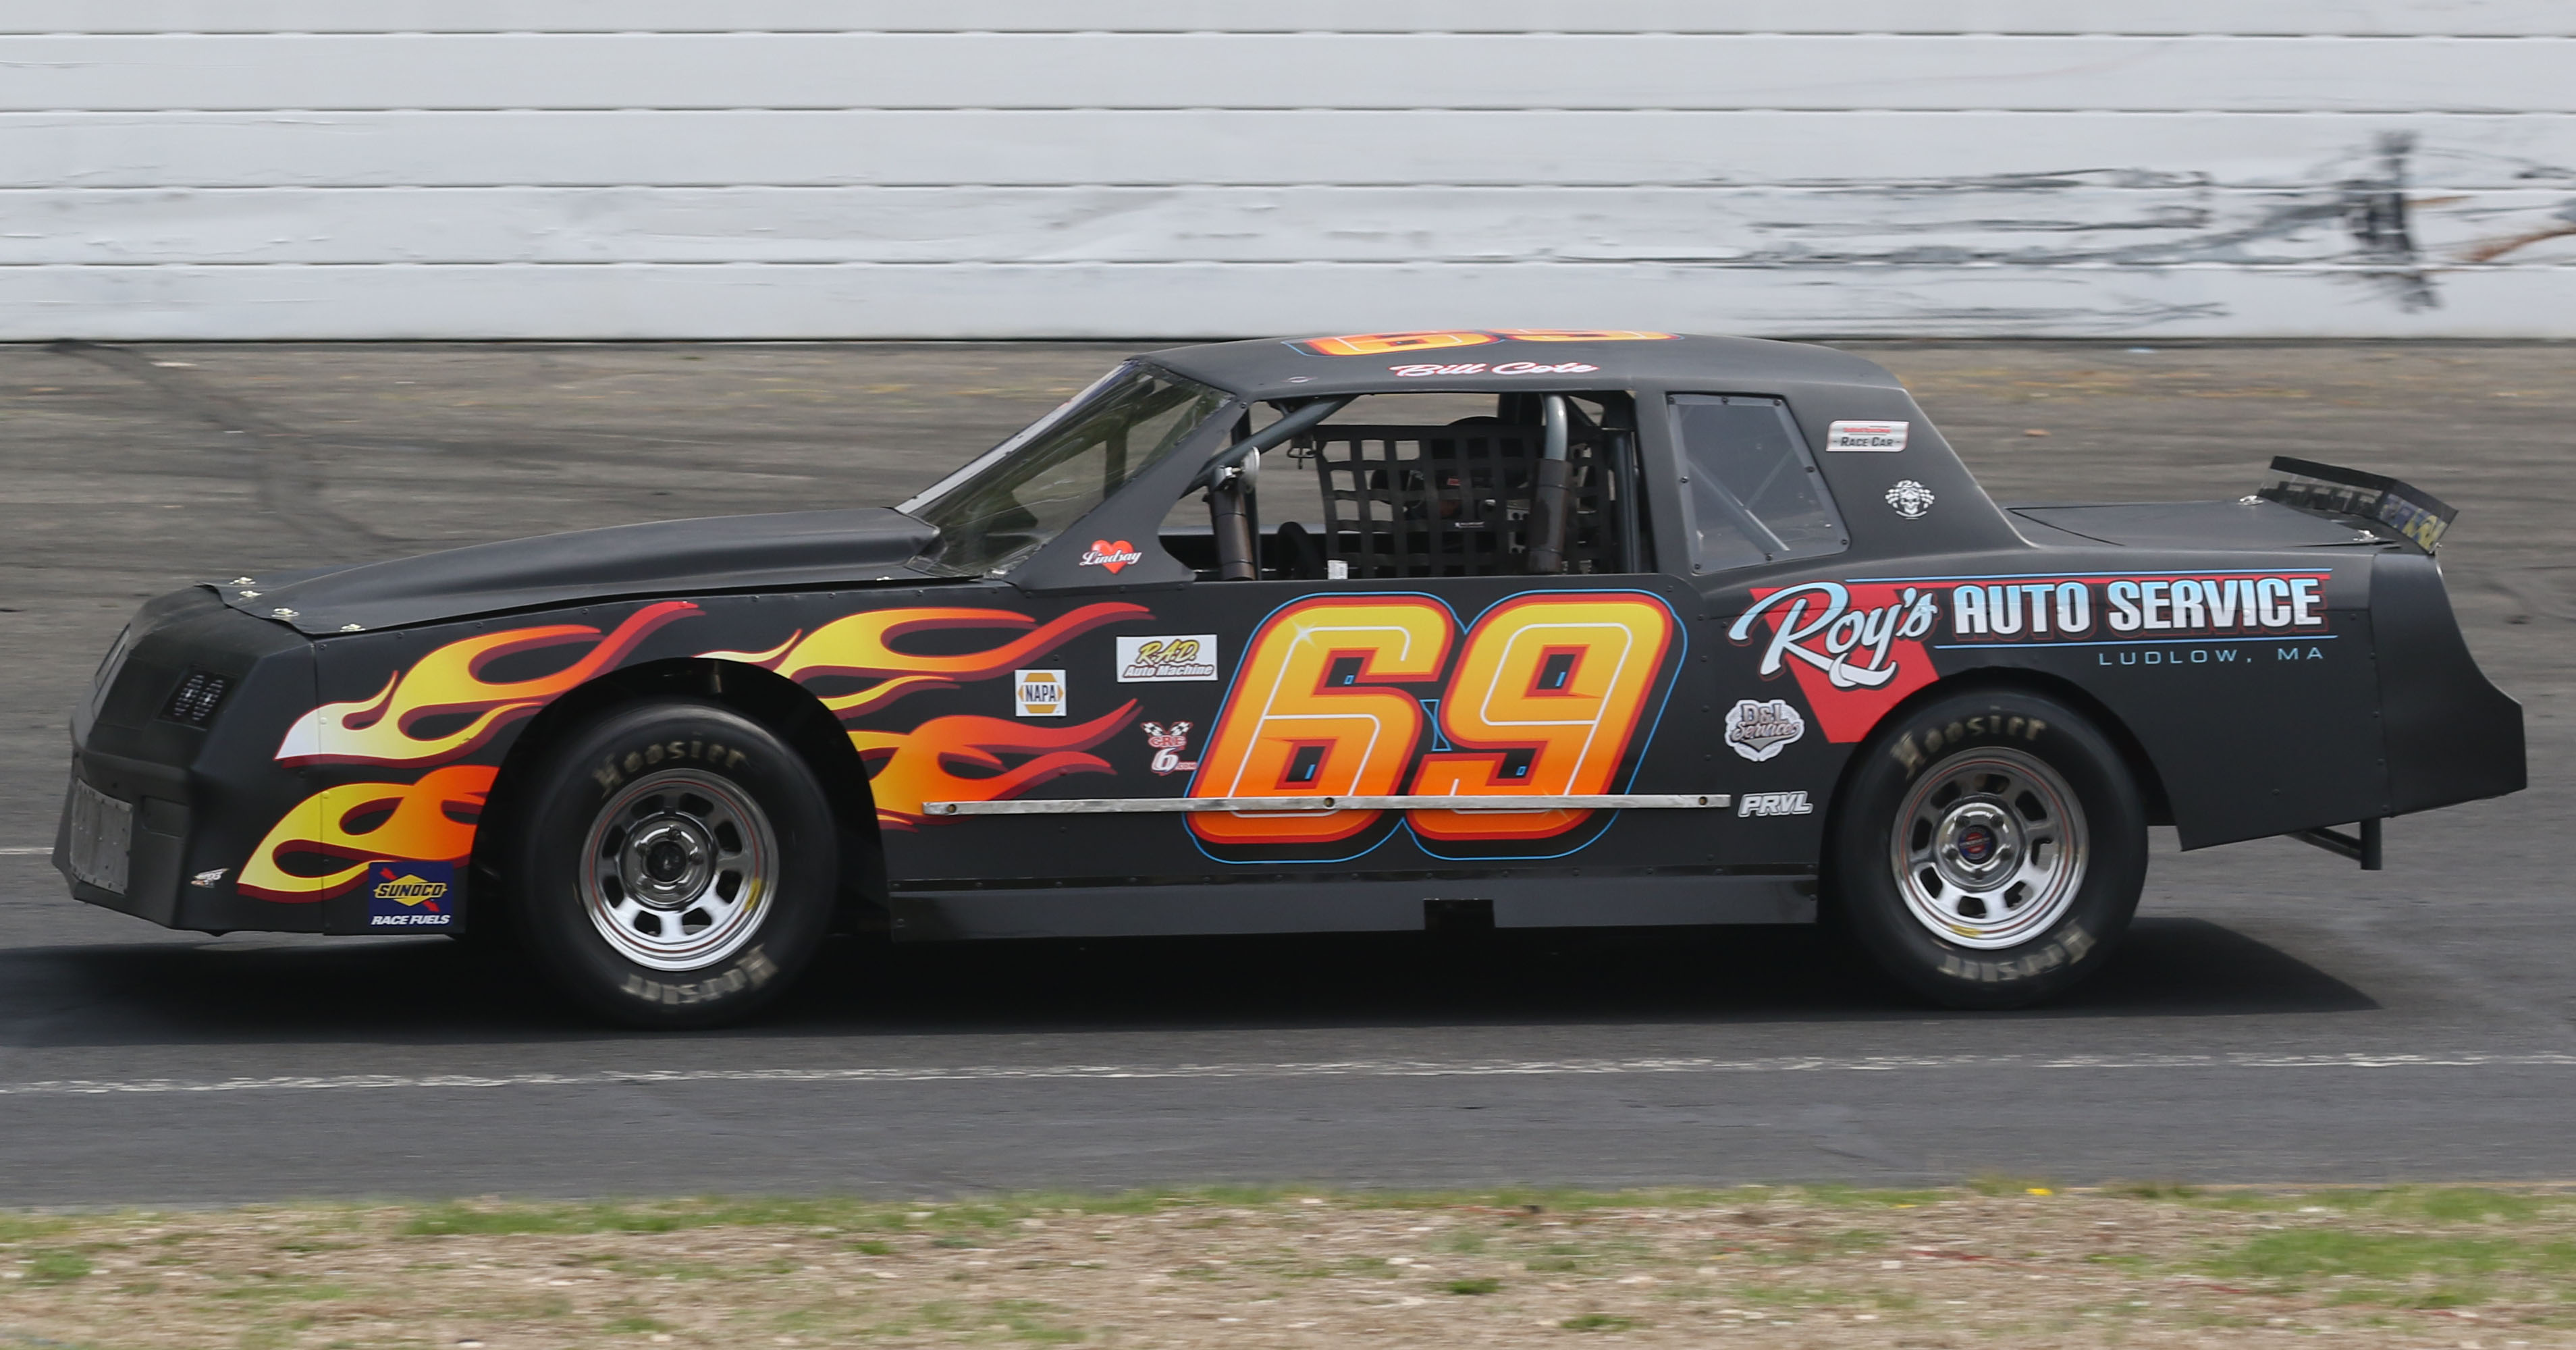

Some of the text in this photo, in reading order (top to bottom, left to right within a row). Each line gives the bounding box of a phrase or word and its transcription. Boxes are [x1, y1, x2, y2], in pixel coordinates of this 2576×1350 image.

[1389, 362, 1486, 377] Bill
[1079, 549, 1143, 566] Lindsay
[1728, 578, 2322, 687] Roy's AUTO SERVICE
[2099, 647, 2324, 666] LUDLOW, MA
[1123, 664, 1214, 677] Auto Machine
[1025, 684, 1056, 702] NAPA
[1189, 591, 1674, 845] 69
[1741, 703, 1790, 724] D&L
[1731, 722, 1800, 741] Services
[1739, 792, 1813, 815] PRVL
[377, 884, 443, 896] SUNOCO
[371, 915, 451, 925] RACE FUELS
